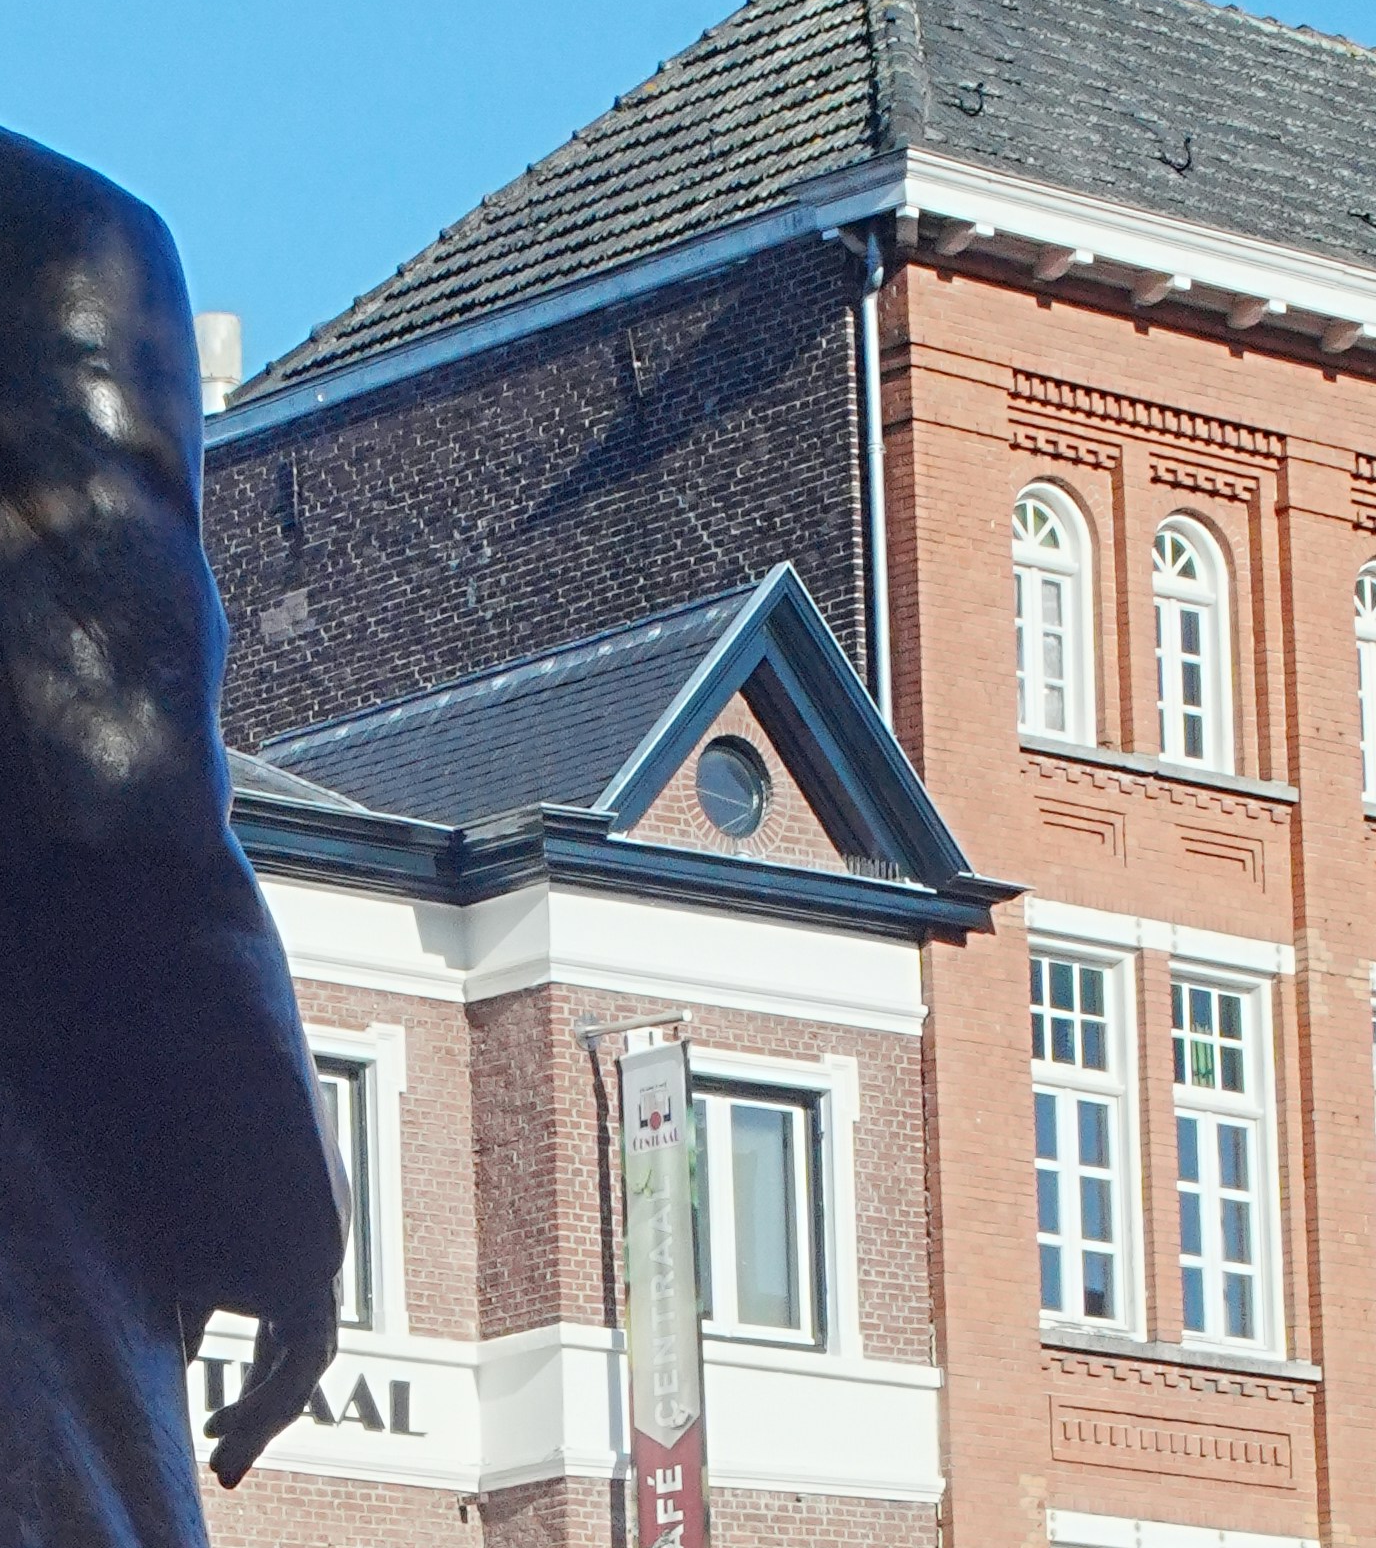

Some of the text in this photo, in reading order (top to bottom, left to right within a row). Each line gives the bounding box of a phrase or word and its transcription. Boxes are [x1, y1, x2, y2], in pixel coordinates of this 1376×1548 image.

[633, 1127, 679, 1152] CENTRAAL
[649, 1174, 691, 1431] CENTRAAL
[197, 1356, 428, 1437] TAAL
